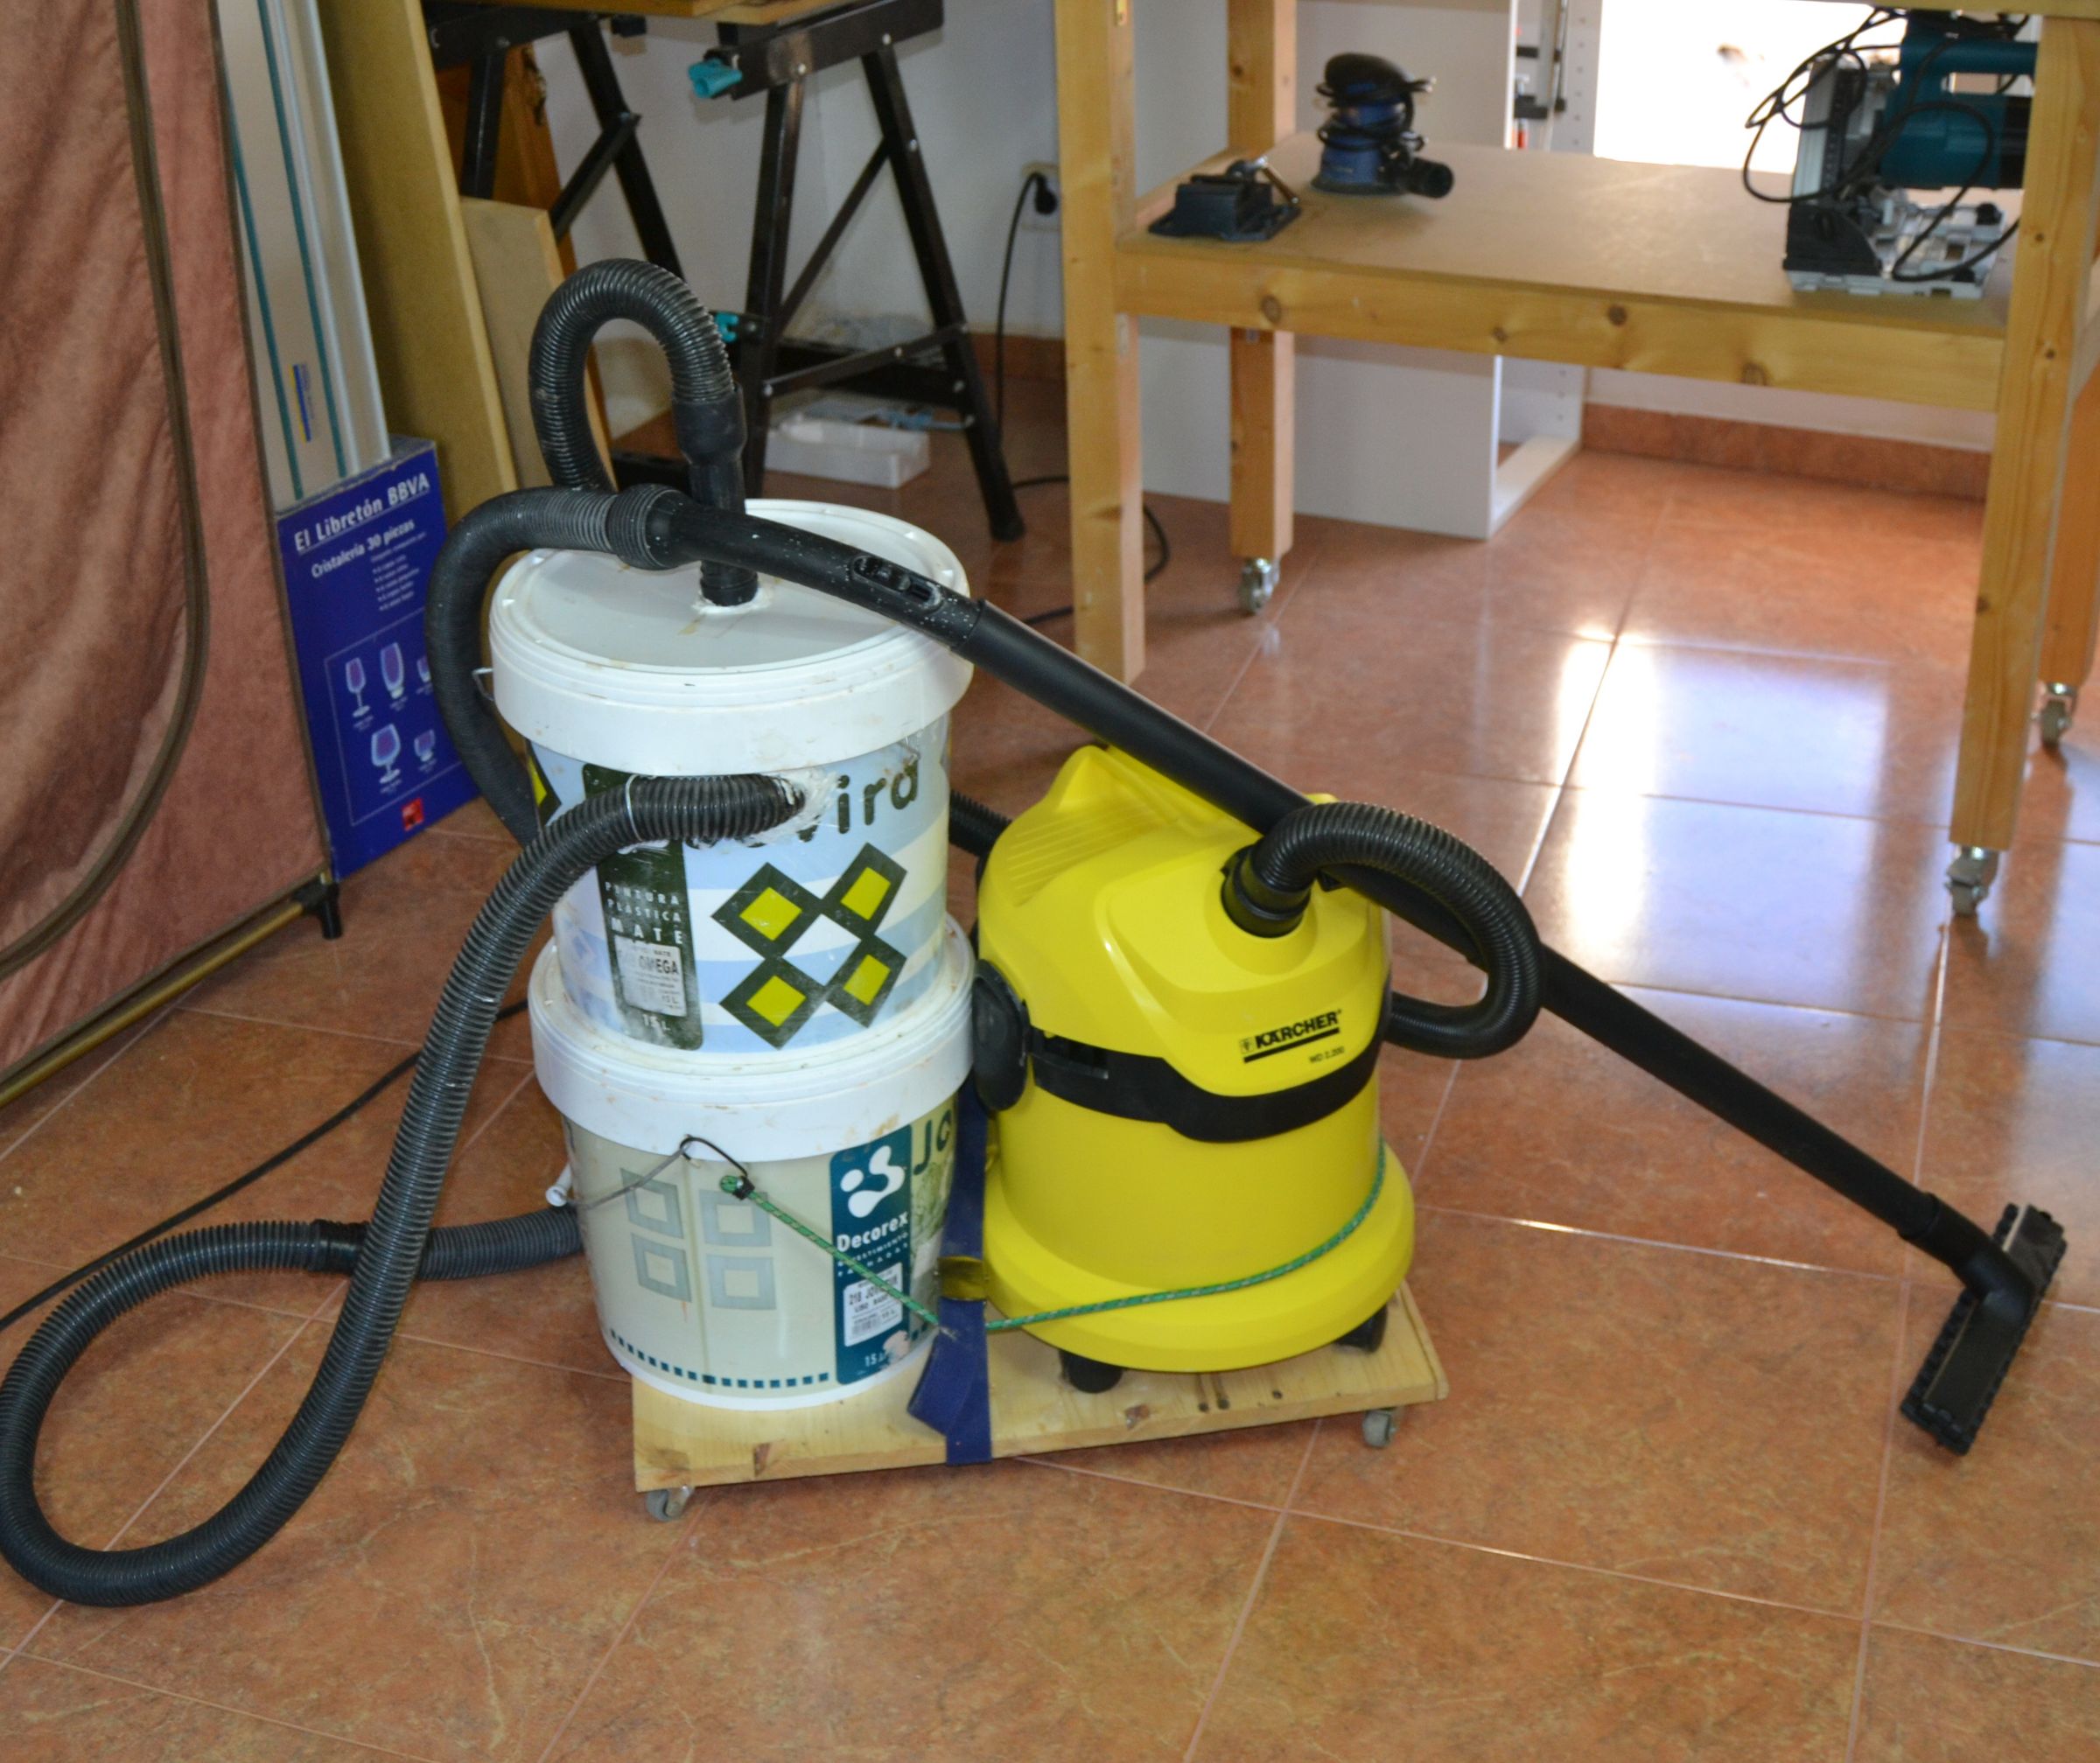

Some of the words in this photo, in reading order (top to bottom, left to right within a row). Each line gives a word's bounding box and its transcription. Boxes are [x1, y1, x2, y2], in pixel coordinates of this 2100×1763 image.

[294, 528, 312, 551] El
[315, 498, 383, 541] Libretón
[388, 472, 430, 506] BBVA
[367, 534, 382, 551] 30
[605, 881, 680, 906] PINTURA
[606, 898, 682, 923] PLASTICA
[611, 917, 683, 945] MATE
[836, 1211, 908, 1252] Decorex
[837, 1231, 908, 1267] RESTIMIENTO
[837, 1242, 908, 1277] FAHADAS
[864, 1354, 877, 1367] 15
